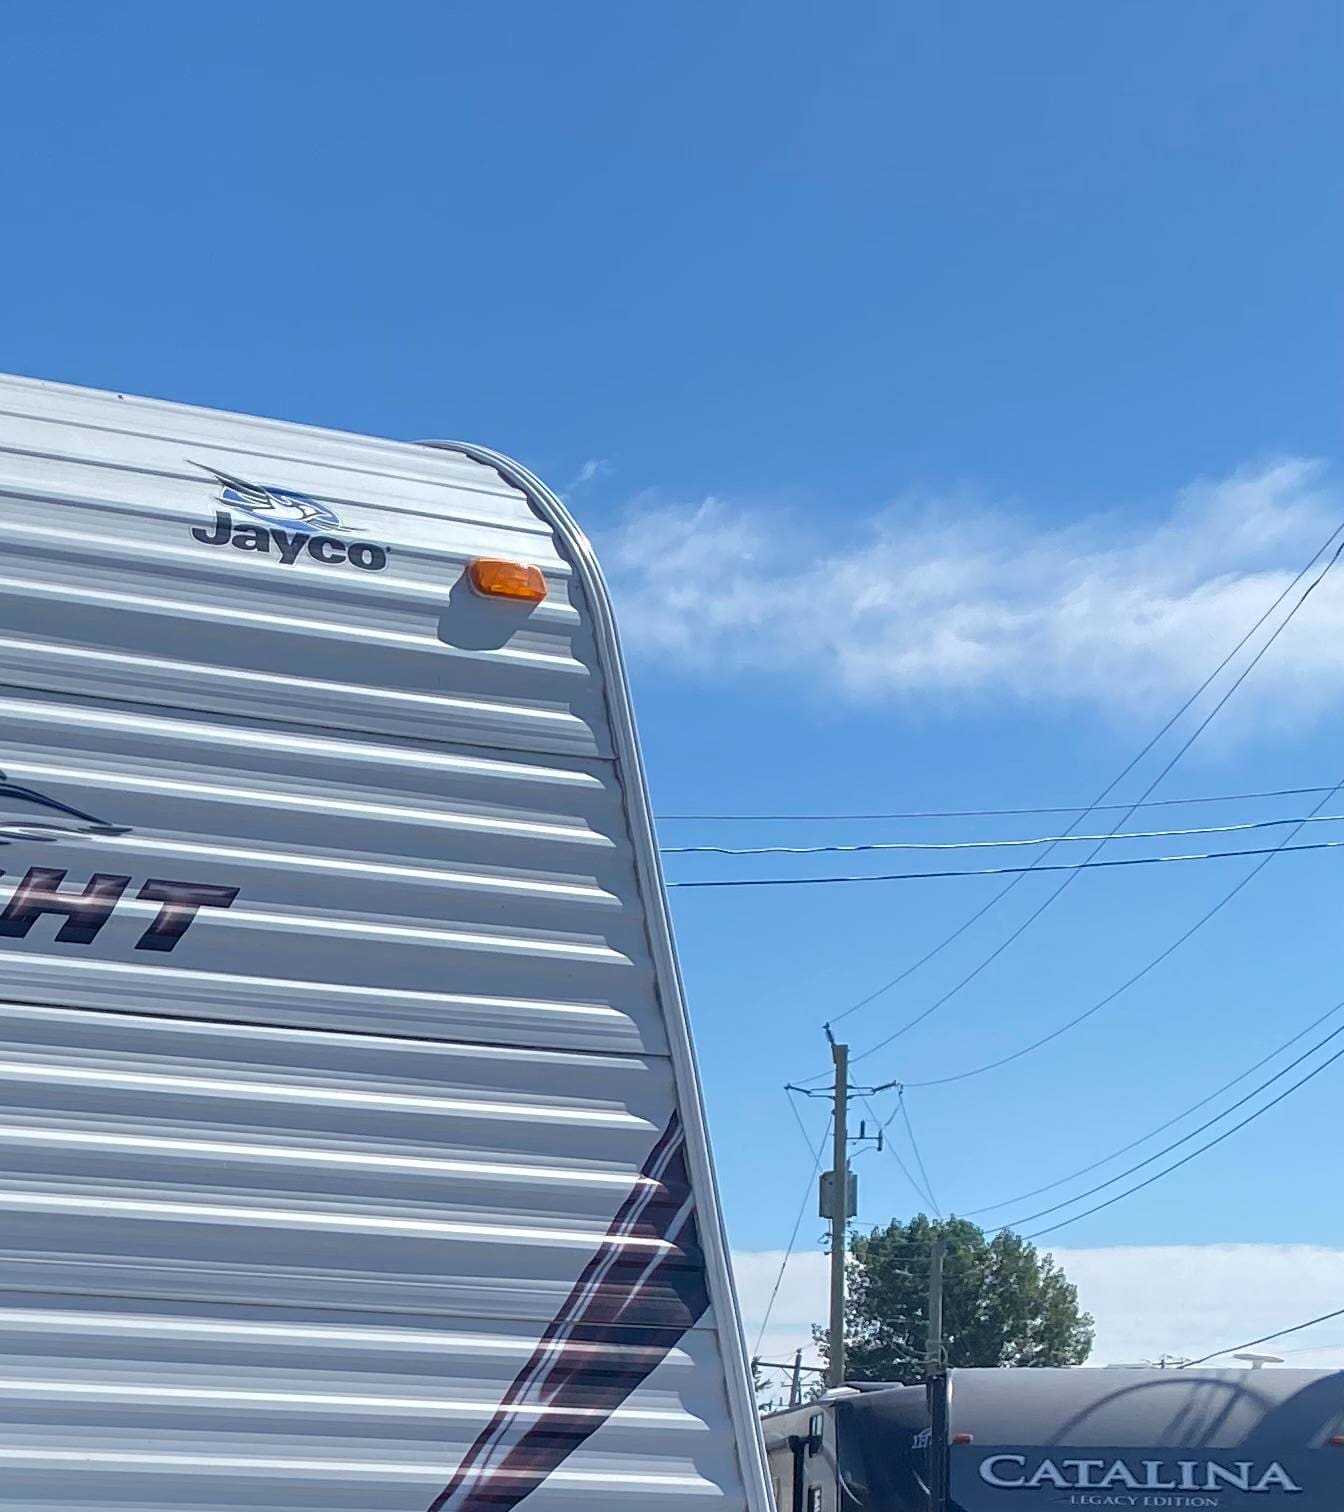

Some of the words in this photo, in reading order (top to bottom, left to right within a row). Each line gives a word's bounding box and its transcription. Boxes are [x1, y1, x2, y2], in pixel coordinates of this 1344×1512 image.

[190, 511, 387, 572] Jayco
[979, 1454, 1304, 1492] CATALINA
[1070, 1495, 1138, 1506] LEGACY
[1143, 1496, 1219, 1508] EDITION
